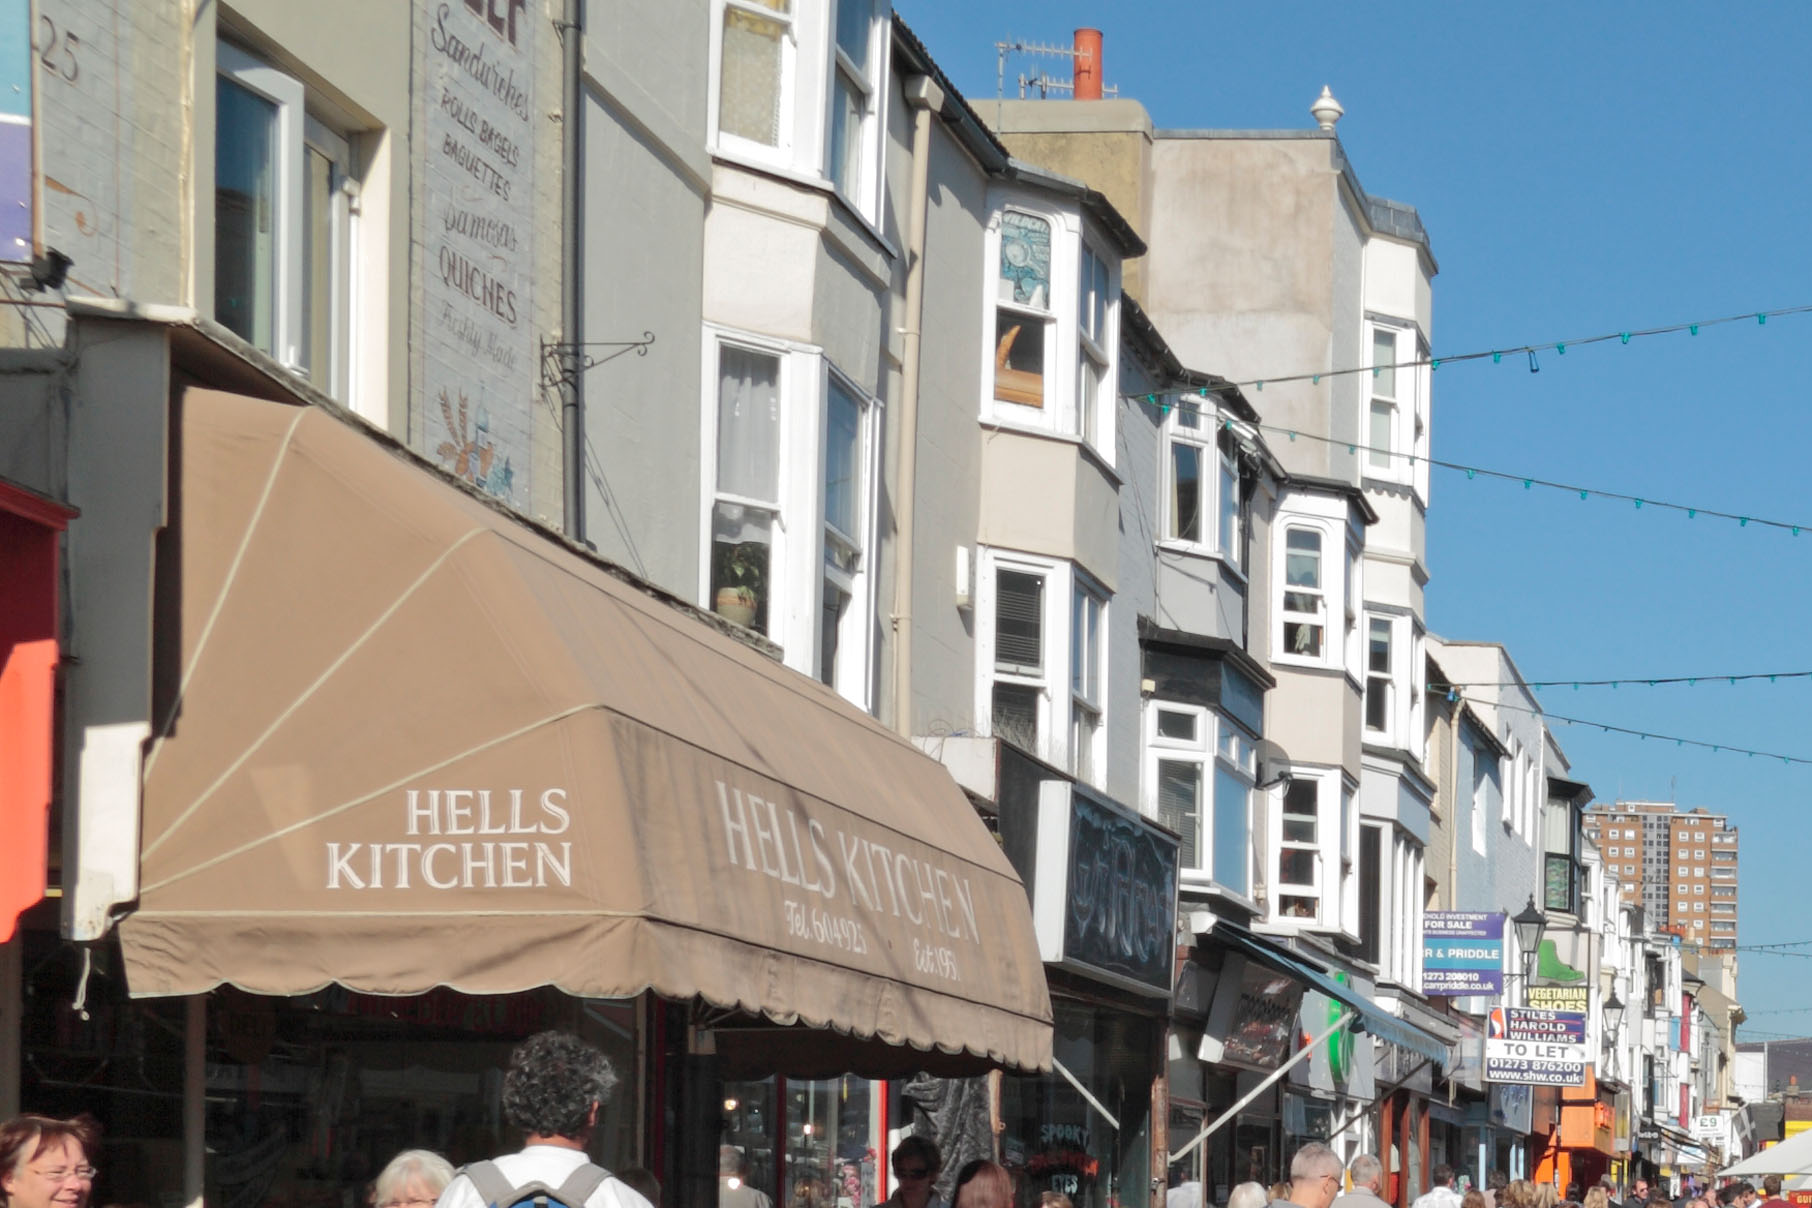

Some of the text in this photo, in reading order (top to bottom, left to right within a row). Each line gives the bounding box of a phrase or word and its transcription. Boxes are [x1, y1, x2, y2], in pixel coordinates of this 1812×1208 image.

[441, 87, 520, 167] ROLLS BAGELS
[443, 133, 512, 201] BAGUETTES
[439, 245, 518, 324] QUICHES
[406, 788, 570, 835] HELLS
[325, 841, 572, 889] KITCHEN
[715, 780, 837, 899] HELLS
[838, 831, 980, 945] KITCHEN
[1447, 921, 1473, 929] SALE
[1437, 949, 1444, 958] &
[1448, 949, 1500, 959] PRIDDLE
[1528, 987, 1586, 999] VEGETARIAN
[1529, 1000, 1587, 1012] SHOES
[1511, 1010, 1556, 1020] STILES
[1511, 1021, 1566, 1032] HAROLD
[1511, 1031, 1577, 1043] WILLIAMS
[1504, 1043, 1569, 1059] TO LET
[1489, 1057, 1581, 1072] 01273 876200
[1489, 1070, 1581, 1083] www.shw.co.uk
[1040, 1124, 1089, 1149] SPOOKY
[1052, 1174, 1078, 1194] EYES
